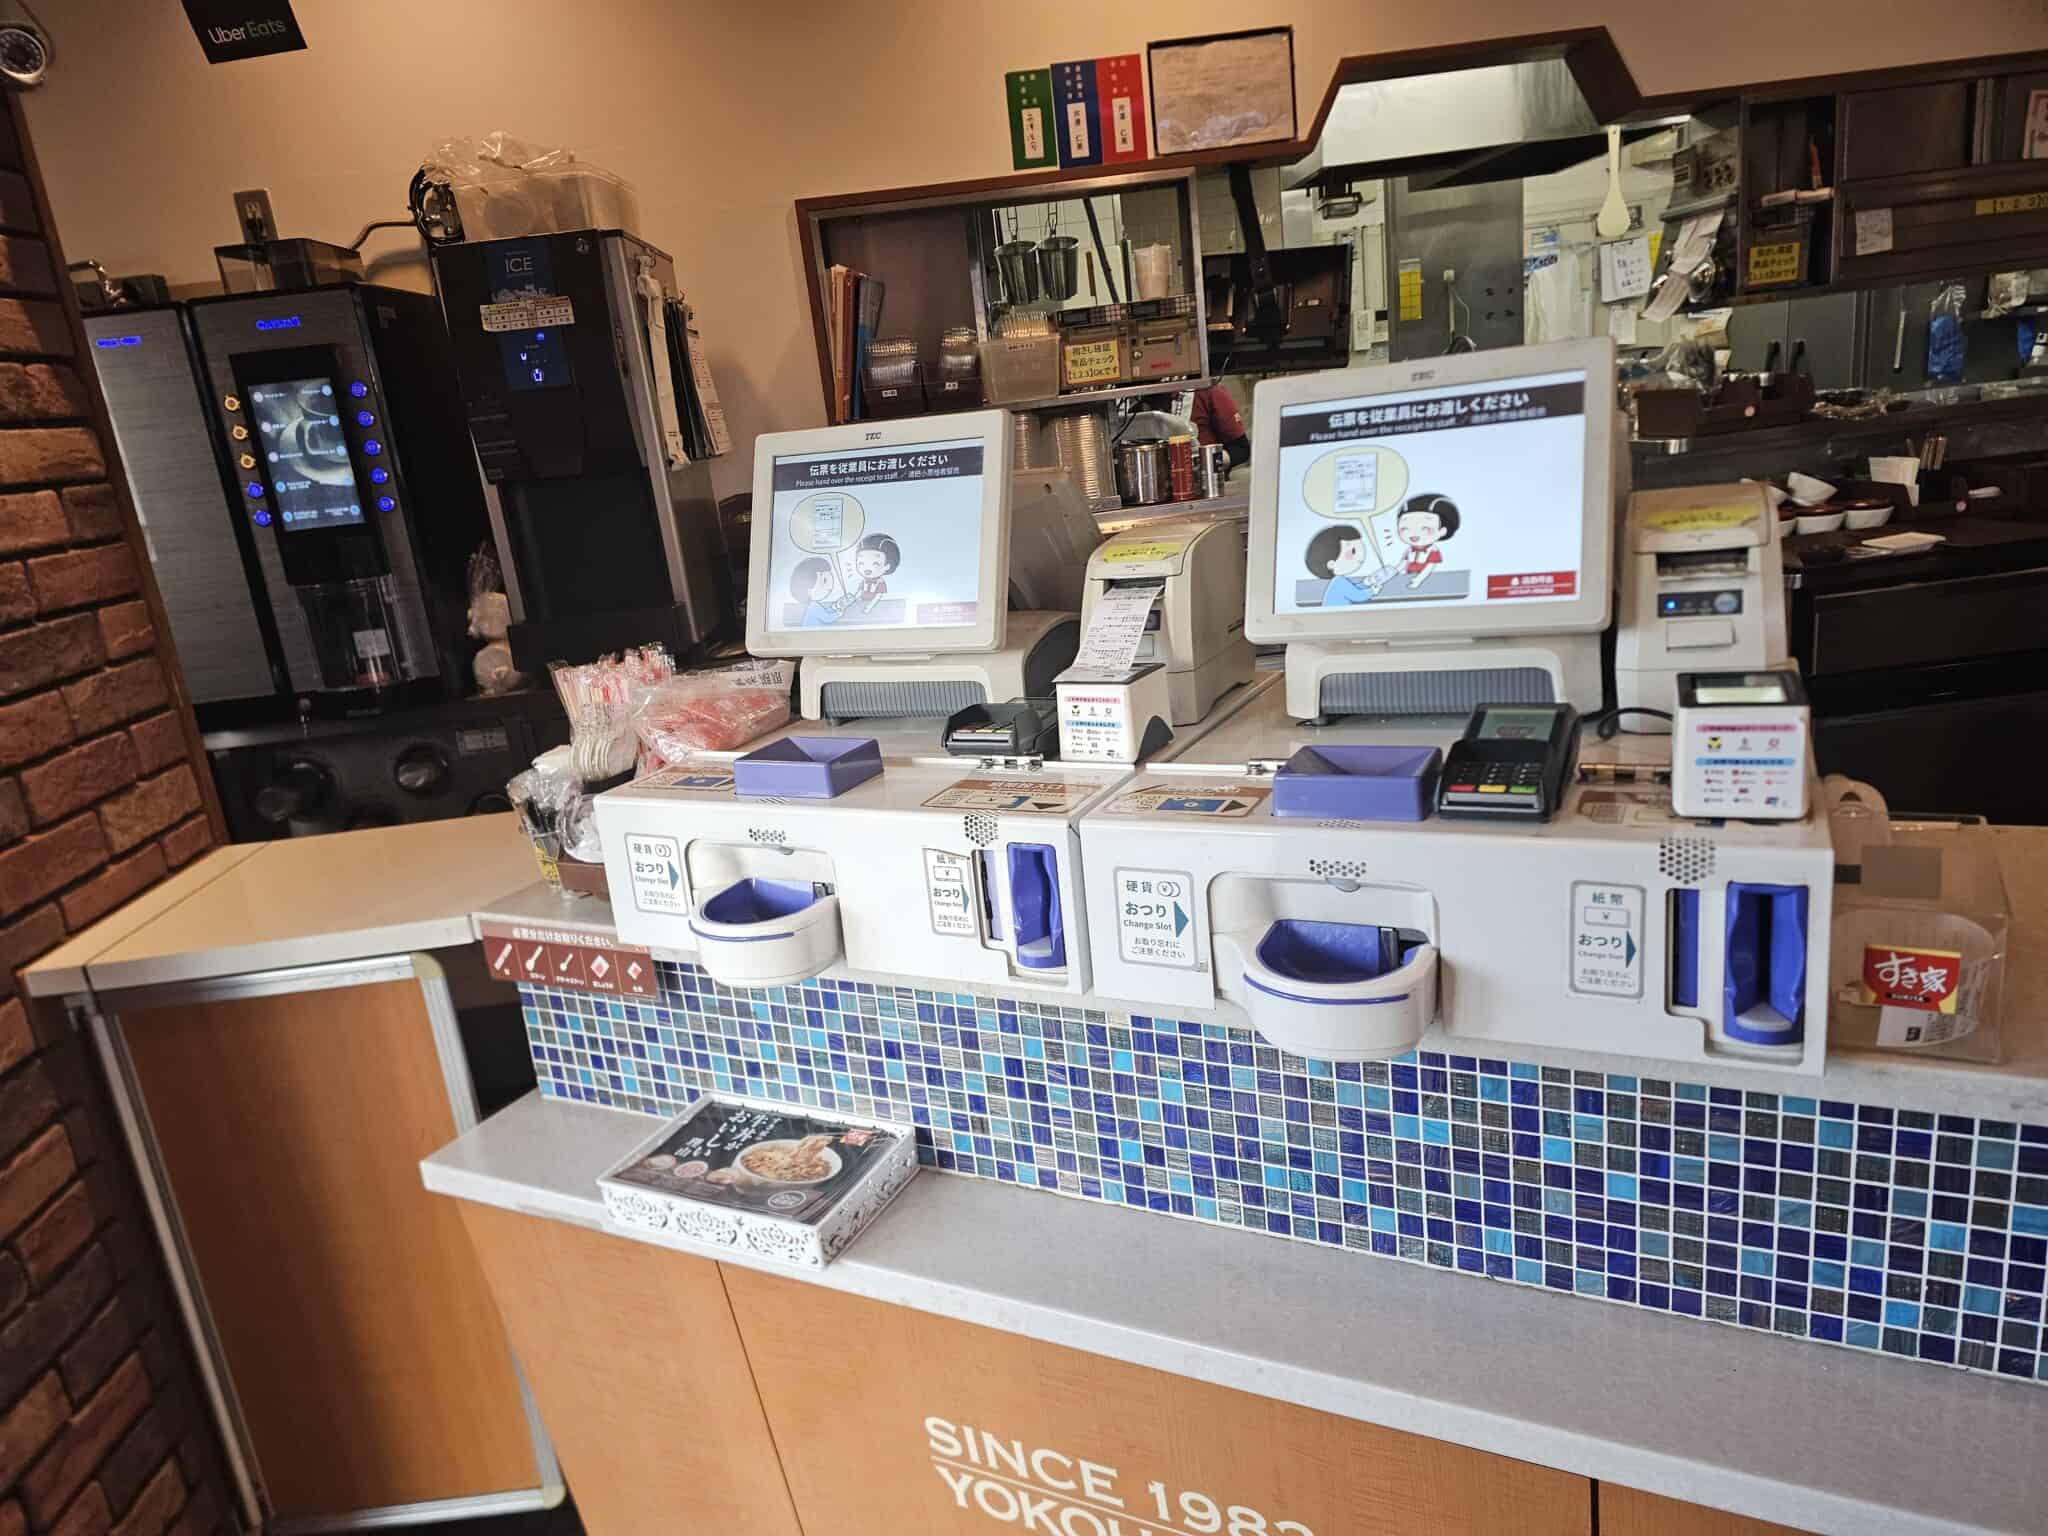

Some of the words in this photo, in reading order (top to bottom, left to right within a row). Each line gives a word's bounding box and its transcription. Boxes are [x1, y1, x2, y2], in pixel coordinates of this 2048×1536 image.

[208, 26, 246, 44] Uber
[246, 19, 287, 39] Eats
[504, 256, 534, 273] ICE
[1328, 393, 1530, 429] 伝票を従業員にお渡しください
[809, 454, 949, 477] 伝票を従業員にお渡しください
[795, 478, 814, 488] Please
[814, 476, 830, 486] hand
[830, 476, 845, 485] over
[844, 475, 855, 484] the
[855, 474, 876, 485] receipt
[635, 861, 664, 875] おつり
[933, 887, 961, 899] おつり
[1126, 880, 1154, 895] 硬貨
[1591, 890, 1626, 906] 紙幣
[1125, 901, 1168, 918] おつり
[1123, 919, 1155, 932] Change
[1155, 921, 1174, 932] Slot
[1578, 933, 1623, 950] おつり
[1130, 946, 1187, 960] ご注意ください
[1578, 950, 1606, 961] Change
[1873, 951, 1949, 996] すき家
[924, 1416, 1125, 1508] SINCE
